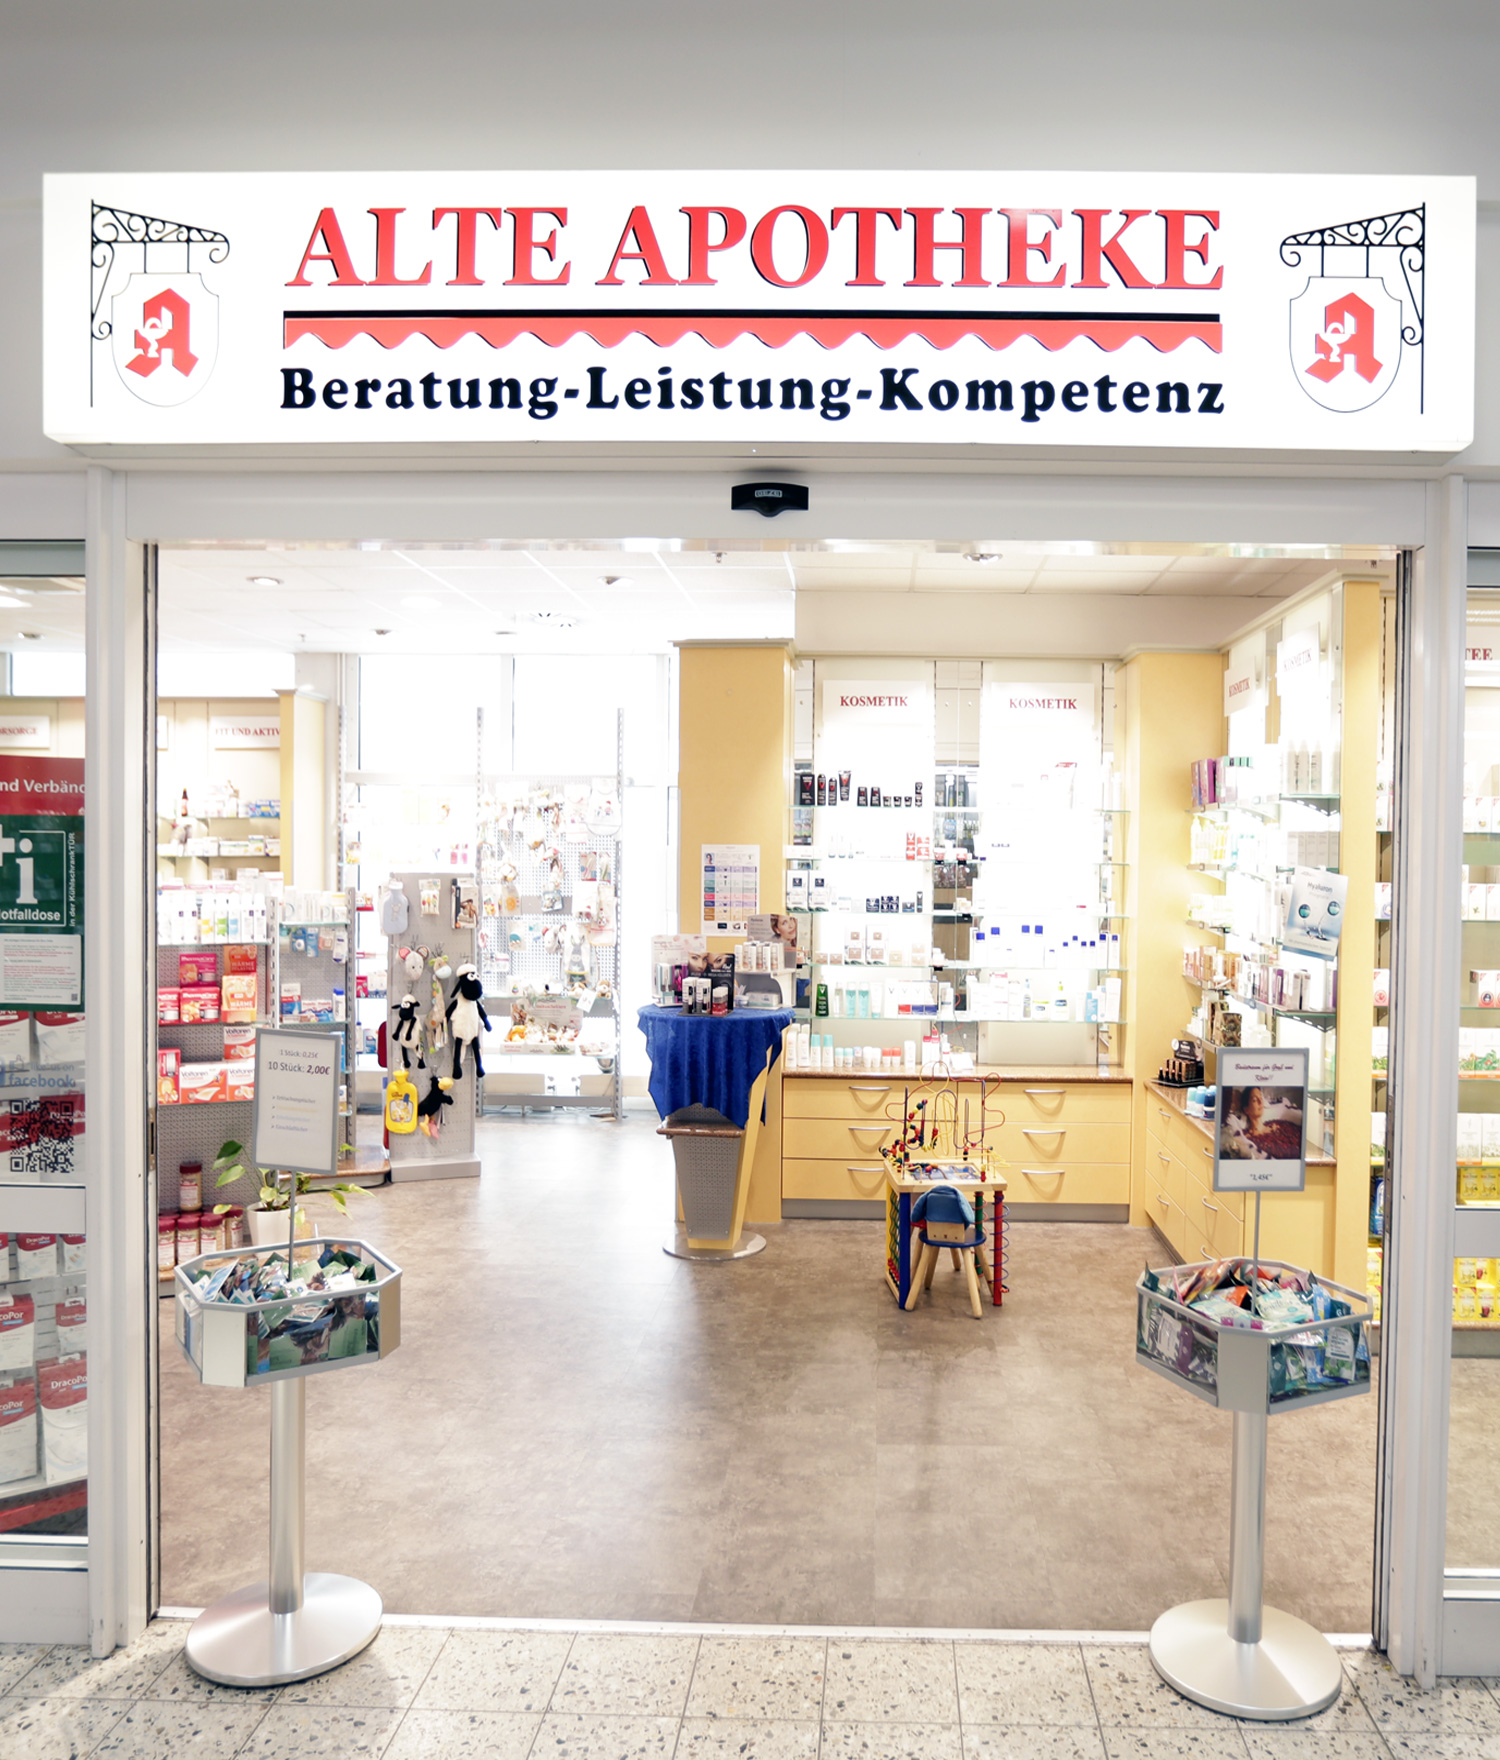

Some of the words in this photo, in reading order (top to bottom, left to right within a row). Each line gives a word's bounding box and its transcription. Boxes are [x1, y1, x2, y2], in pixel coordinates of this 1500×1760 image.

[286, 207, 571, 286] ALTE
[595, 205, 1223, 289] APOTHEKE
[281, 367, 1223, 421] Beratung-Leistung-Kompetenz
[840, 696, 908, 707] KOSMETIK
[1009, 698, 1077, 710] KOSMETIK
[0, 726, 37, 736] RSORGE
[231, 728, 251, 736] UND
[253, 728, 280, 736] AKTIV
[268, 1061, 278, 1070] 10
[280, 1062, 305, 1073] Stück:
[306, 1065, 331, 1075] 2,00€
[8, 1074, 75, 1087] facebook
